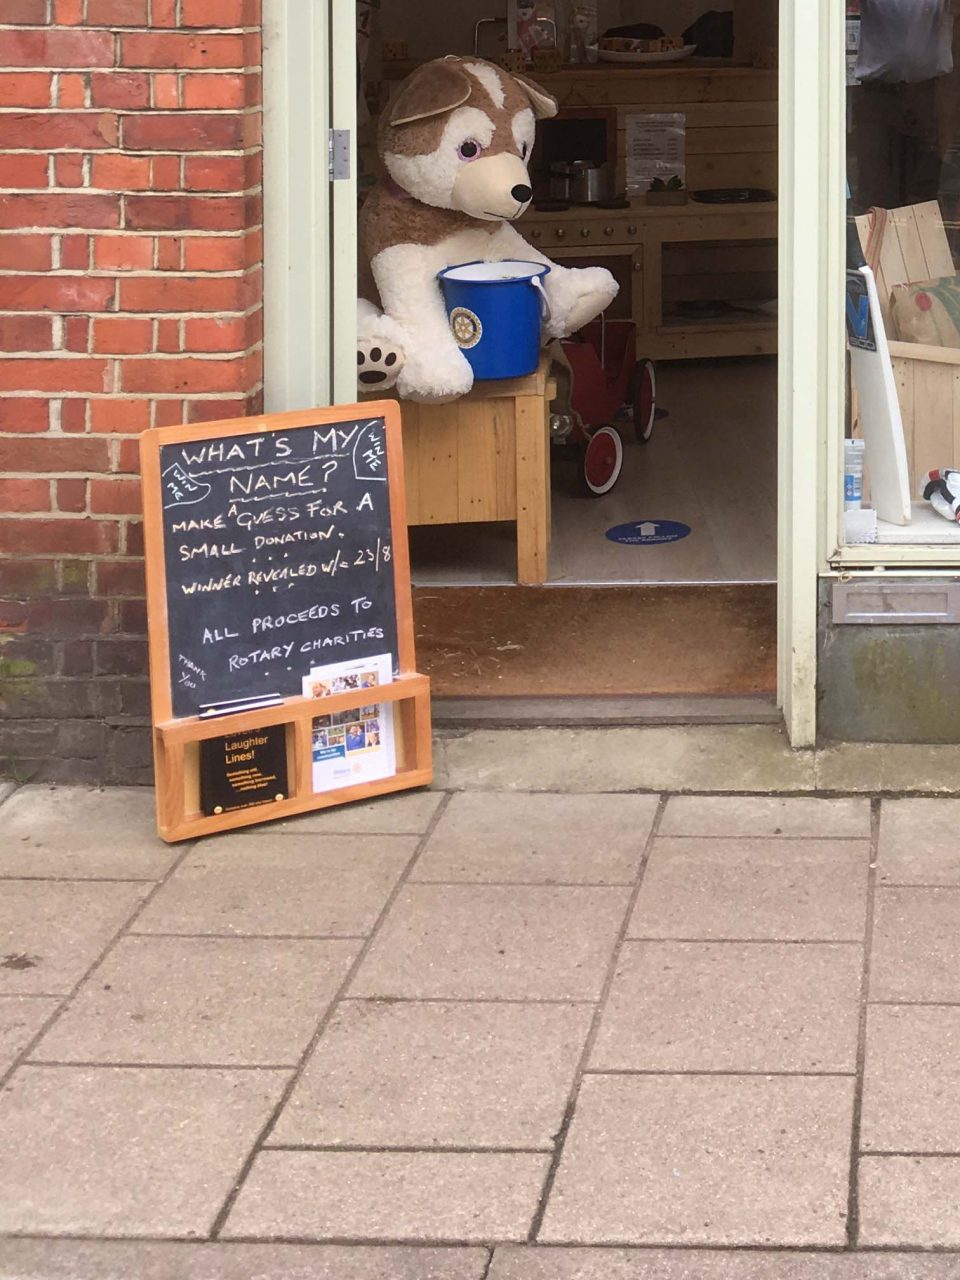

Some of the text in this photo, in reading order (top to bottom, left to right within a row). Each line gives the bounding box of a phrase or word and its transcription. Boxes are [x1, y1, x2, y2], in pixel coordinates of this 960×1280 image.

[182, 425, 359, 465] WHAT'S MY
[172, 513, 227, 533] MAKE
[236, 506, 300, 531] GUESS
[306, 500, 348, 518] FOR
[356, 492, 374, 510] A
[179, 543, 246, 562] SMALL
[181, 575, 241, 595] WINNER
[248, 564, 317, 586] REVEALED
[353, 537, 391, 572] 23/8
[202, 596, 373, 644] ALL PROCEEDS TO
[228, 627, 384, 672] ROTARY CHARITIES
[177, 654, 207, 682] THANK
[177, 672, 197, 689] YOU
[225, 736, 269, 752] Laughter
[225, 749, 255, 764] Lines!
